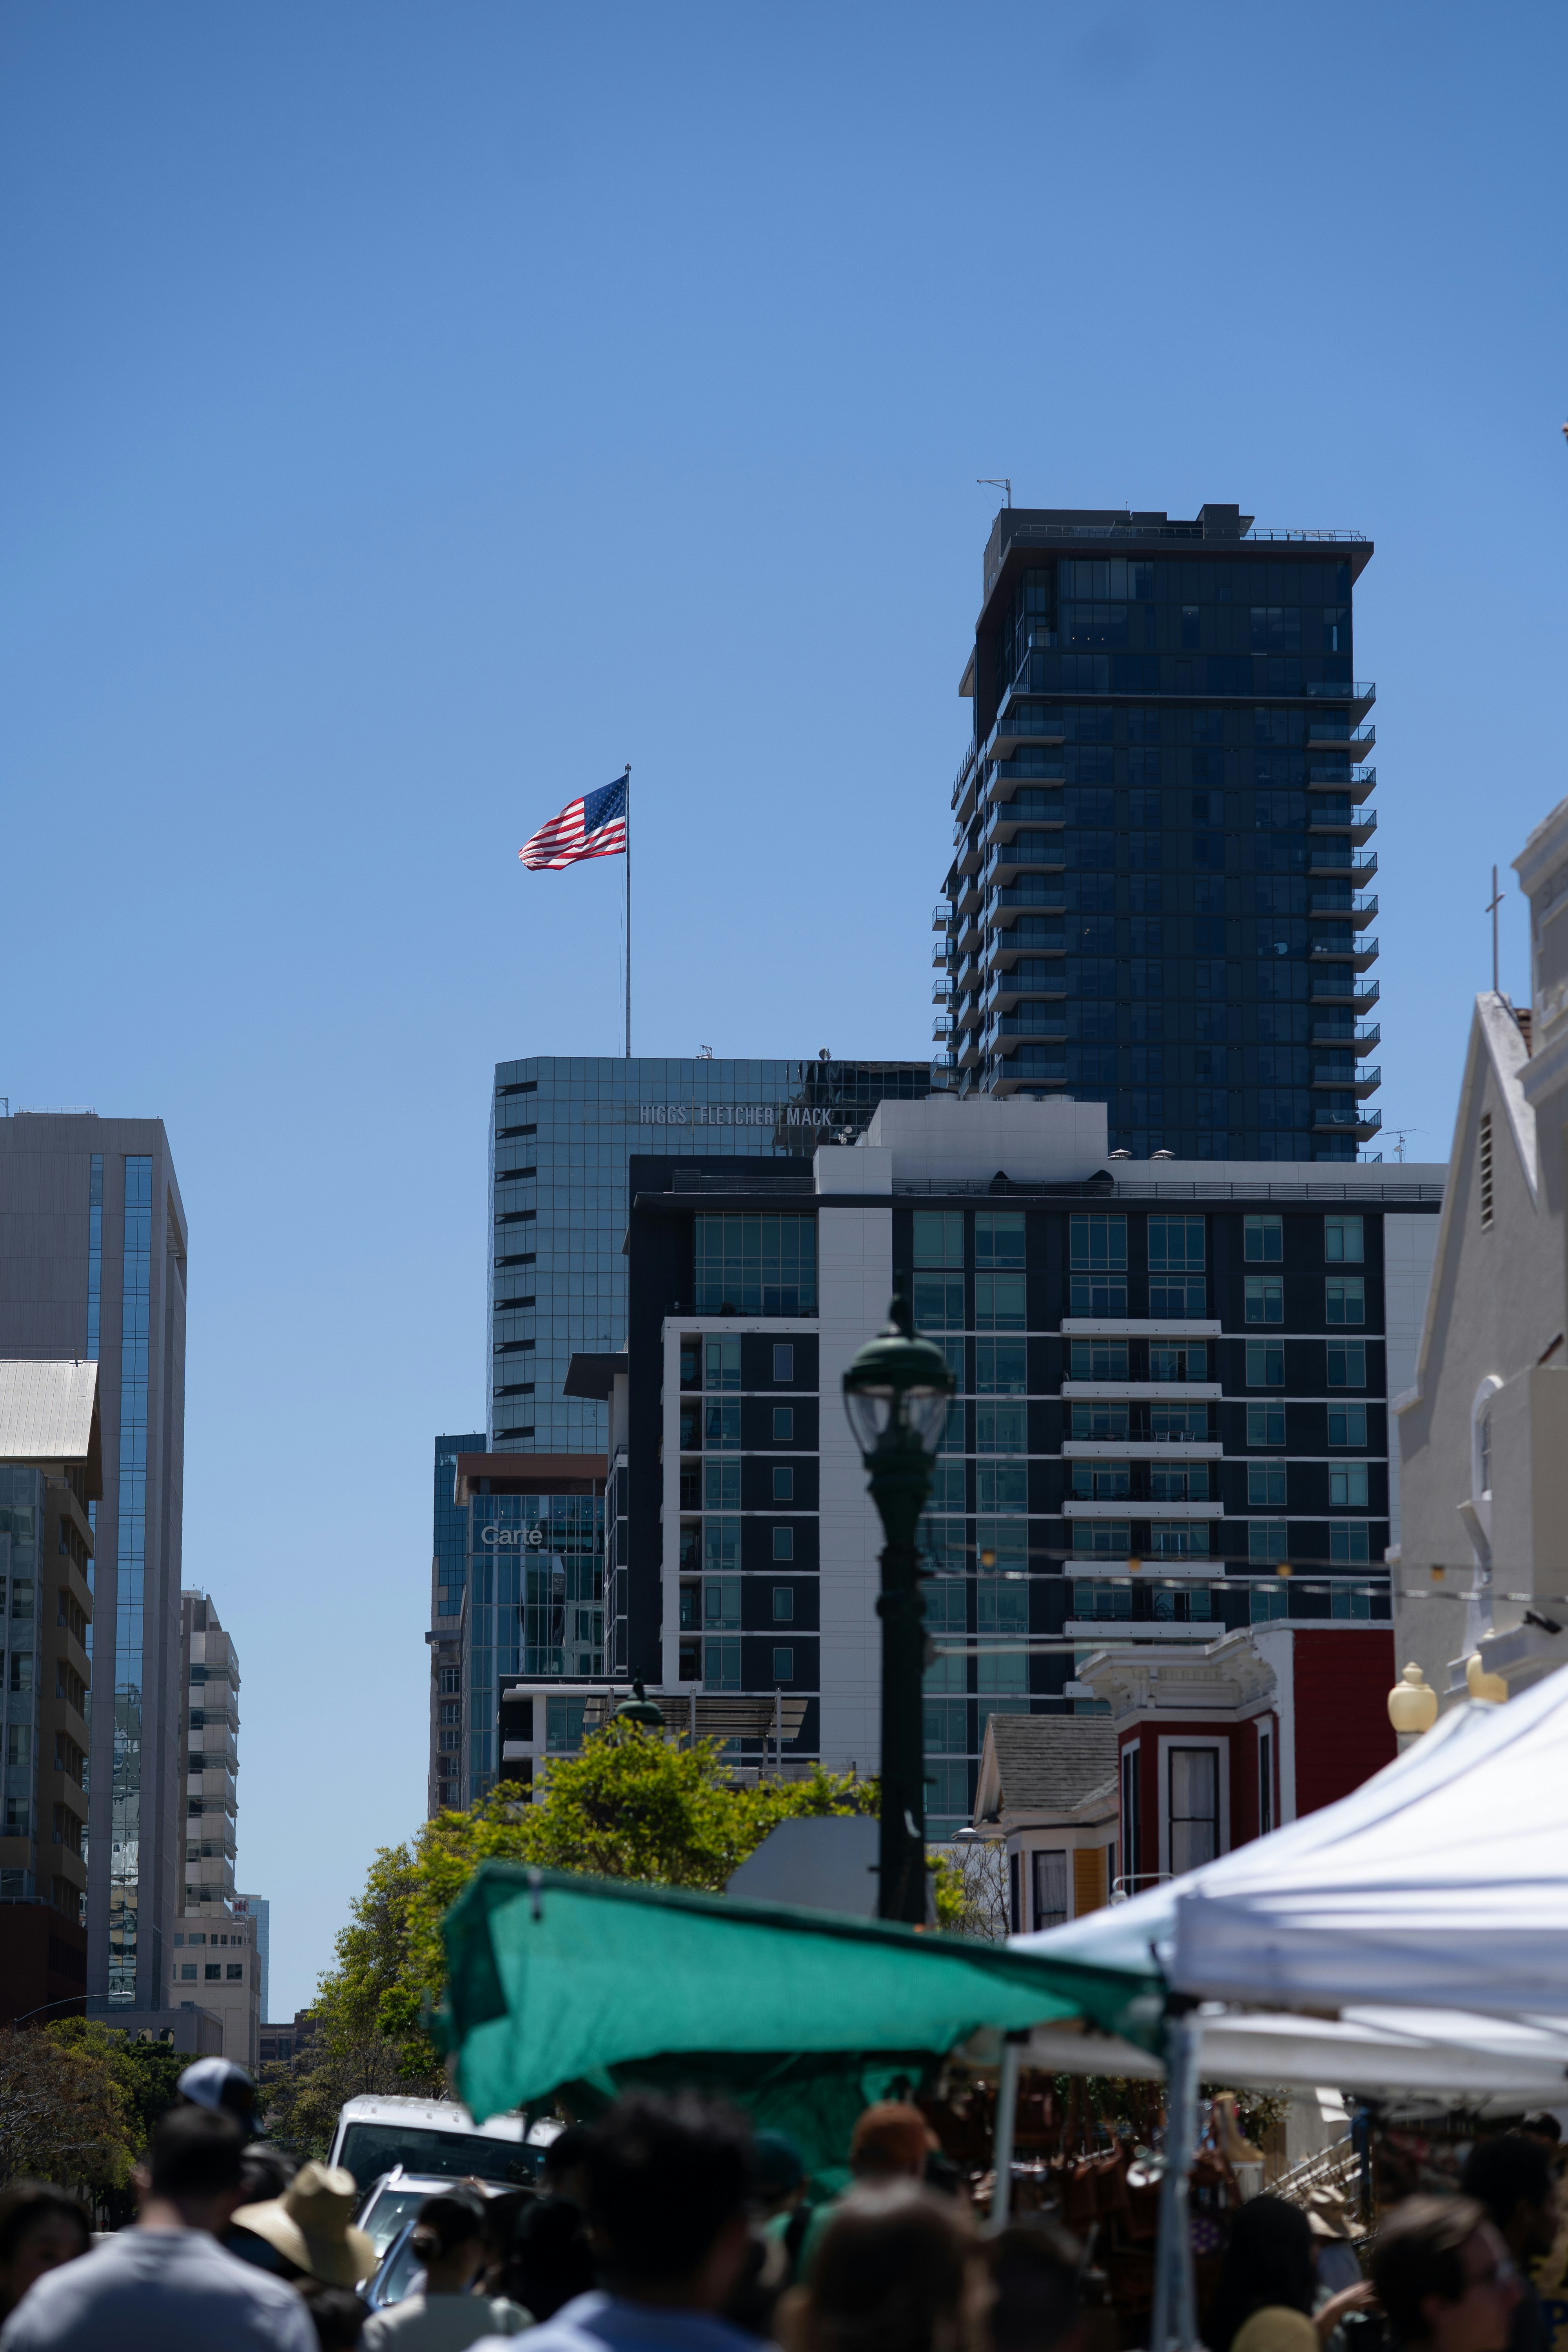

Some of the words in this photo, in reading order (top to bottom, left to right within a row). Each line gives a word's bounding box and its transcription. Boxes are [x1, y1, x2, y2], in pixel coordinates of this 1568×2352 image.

[641, 1105, 686, 1124] HIGGS
[700, 1107, 773, 1125] FLETCHER
[787, 1107, 831, 1126] MACK
[481, 1523, 542, 1545] Carté
